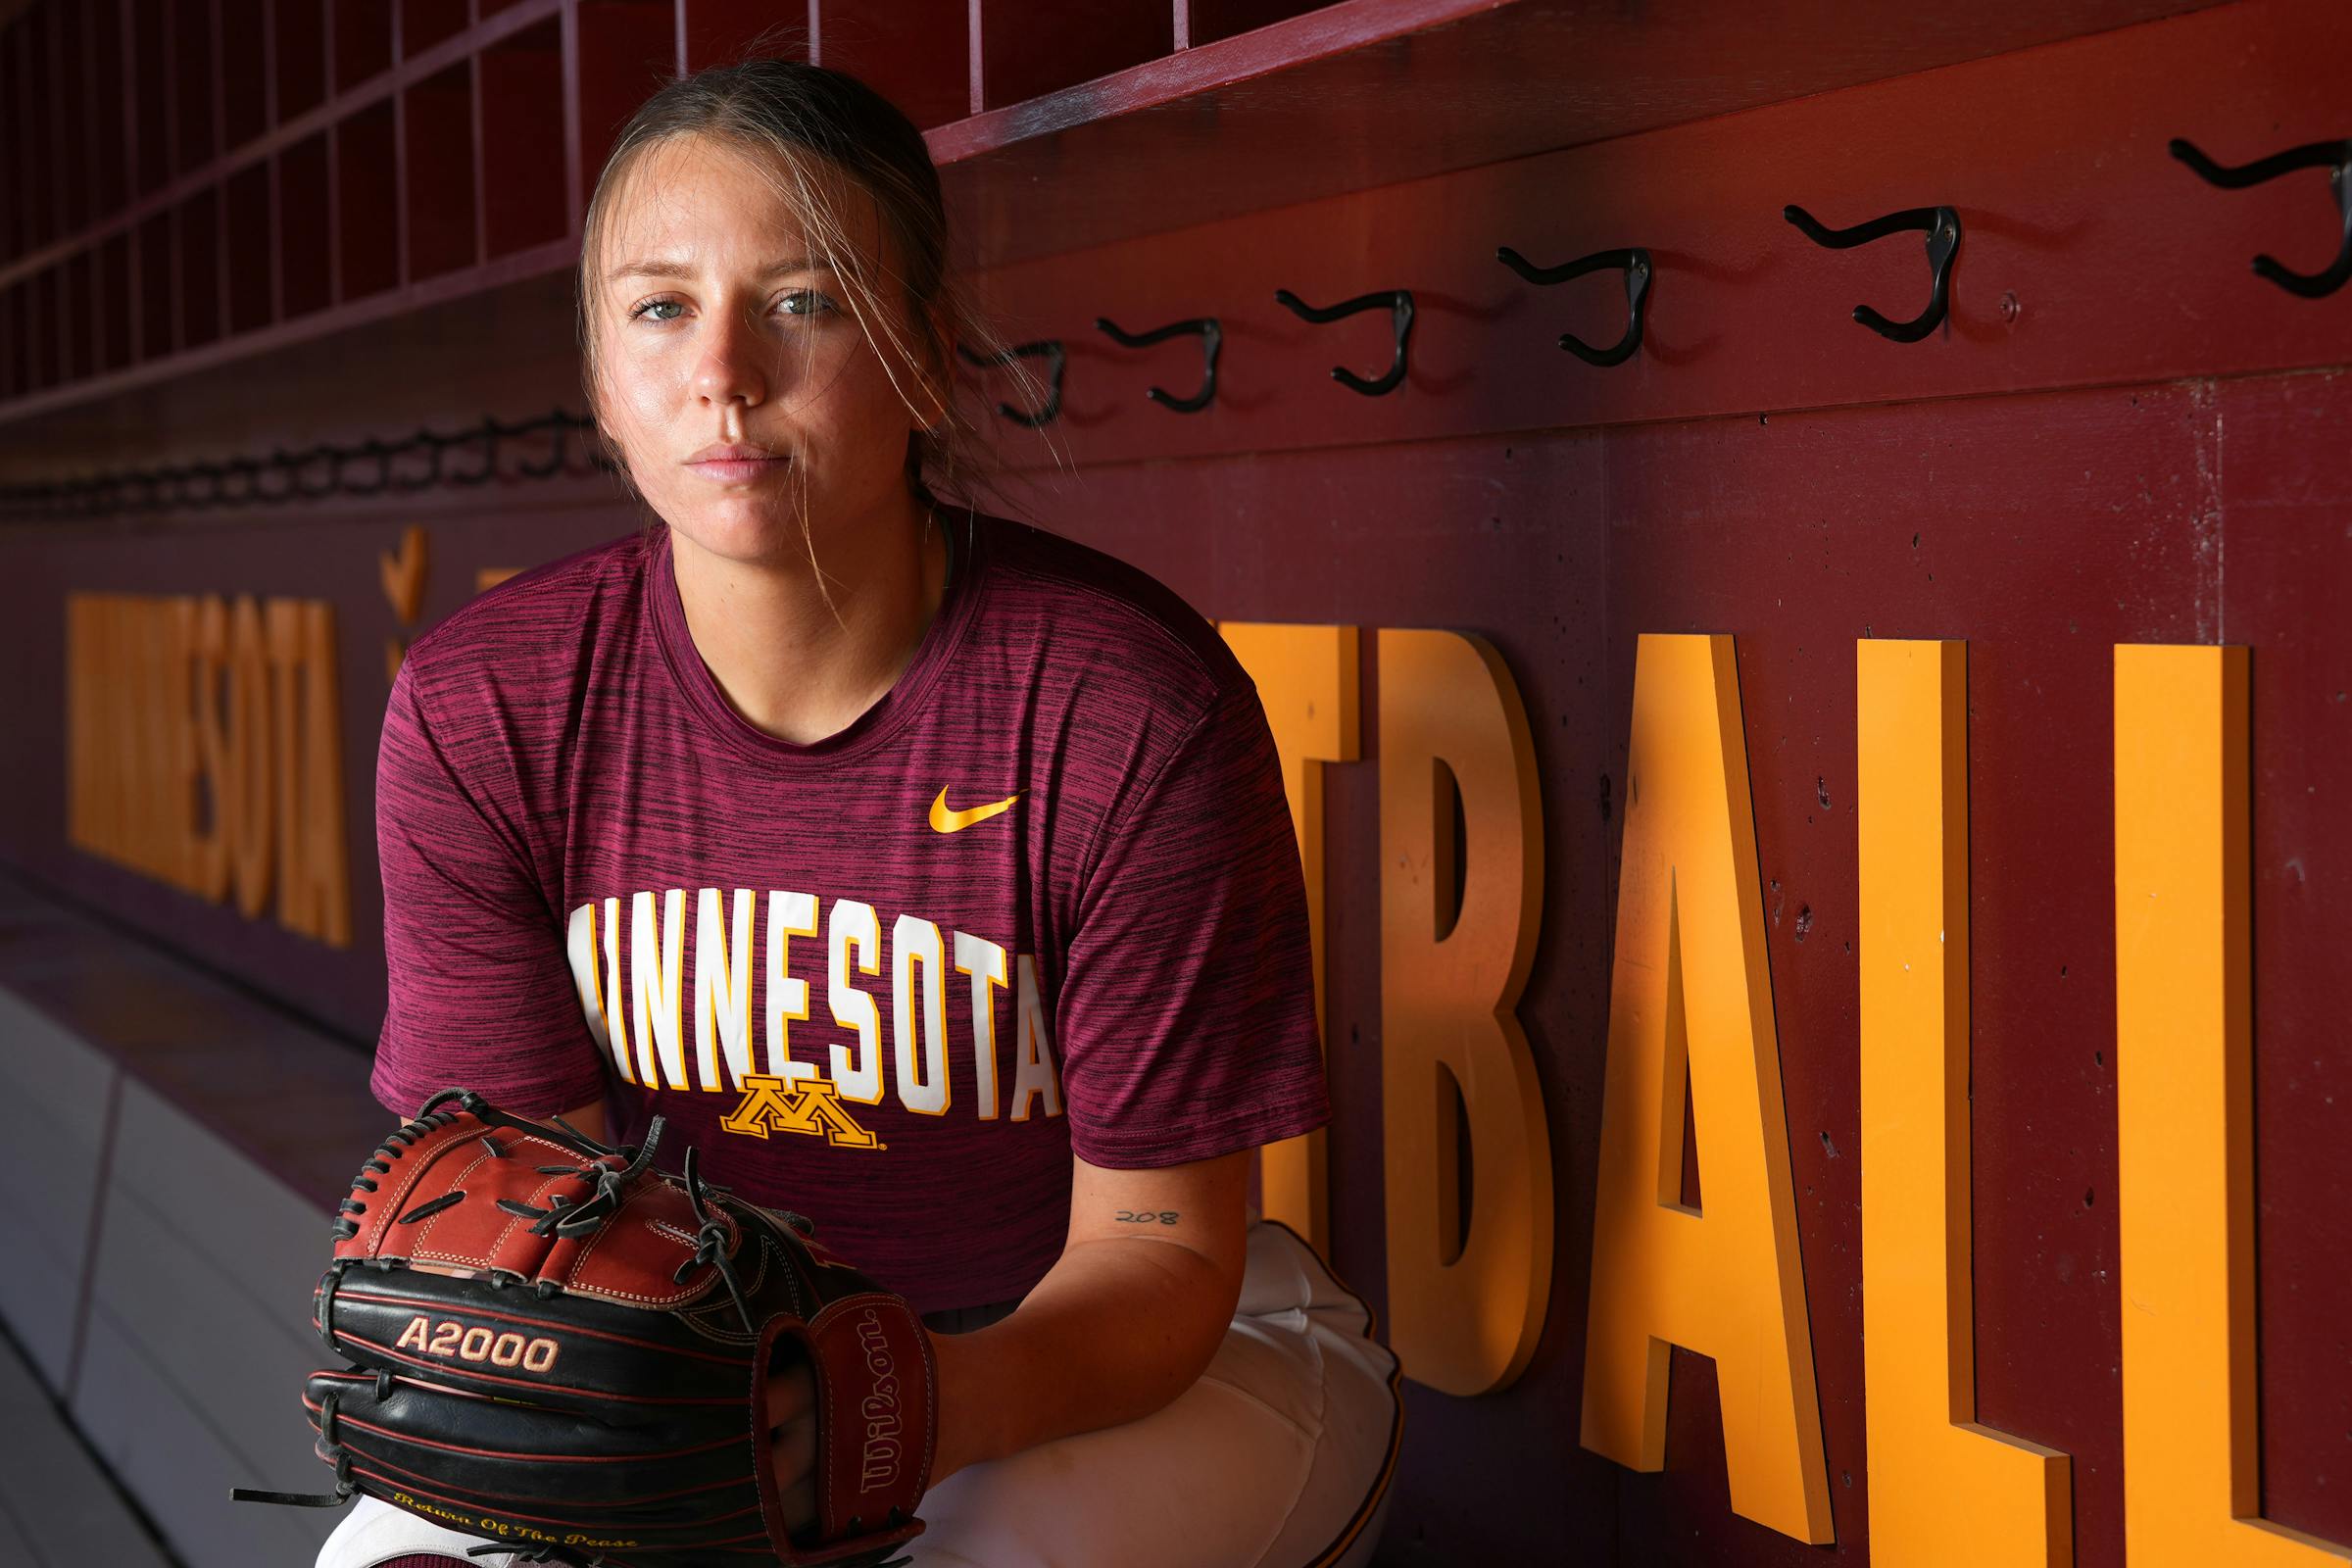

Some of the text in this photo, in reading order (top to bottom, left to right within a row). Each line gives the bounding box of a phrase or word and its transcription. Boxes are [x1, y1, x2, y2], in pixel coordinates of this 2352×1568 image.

[1113, 1210, 1180, 1225] 208
[396, 1314, 561, 1374] A2000
[857, 1308, 903, 1494] Wilson
[394, 1492, 638, 1548] Return Of The Pease
